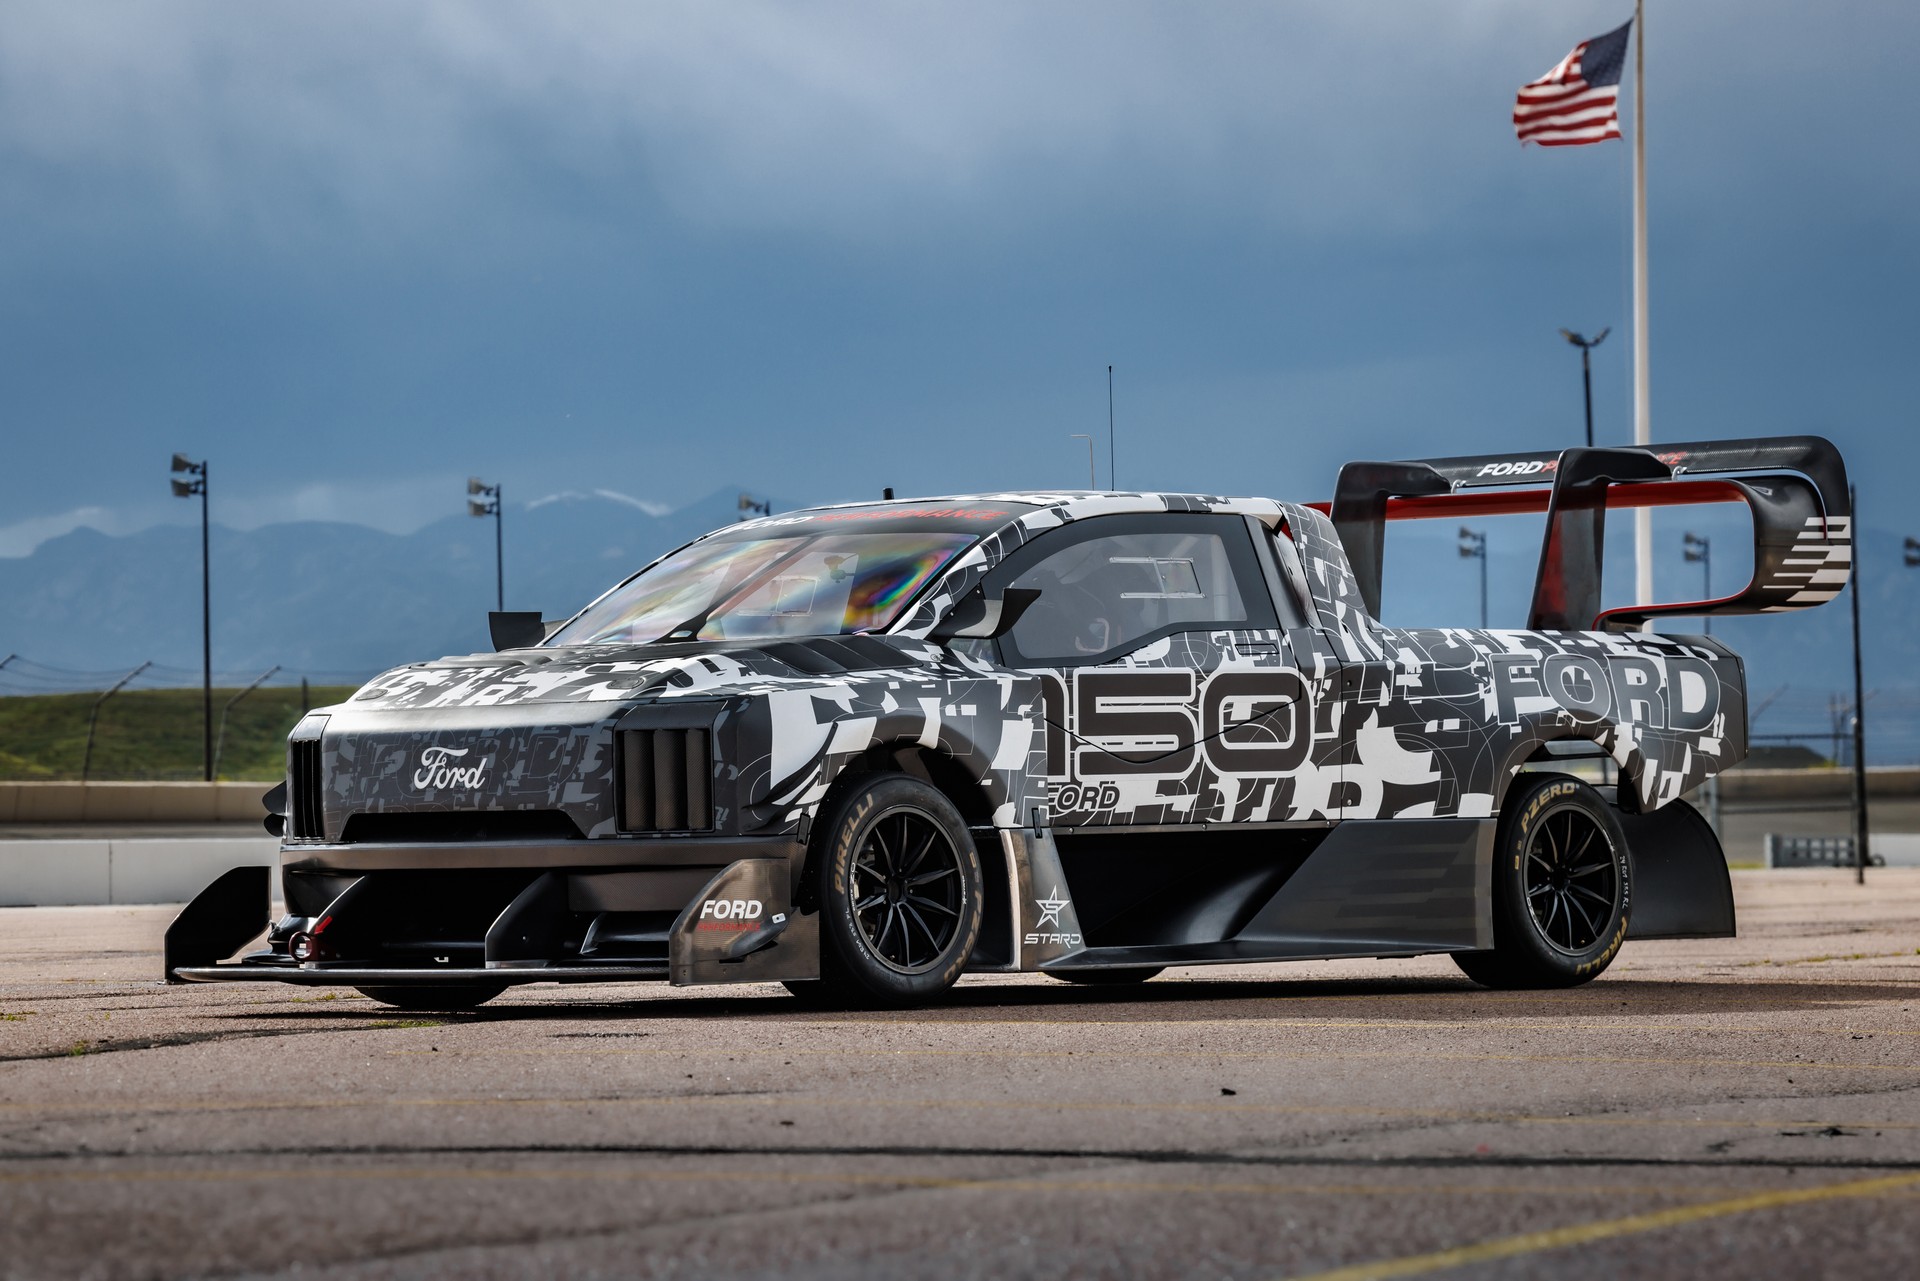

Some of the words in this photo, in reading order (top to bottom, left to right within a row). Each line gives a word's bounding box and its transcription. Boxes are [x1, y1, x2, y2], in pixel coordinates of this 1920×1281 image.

[1477, 460, 1544, 477] FORD
[1489, 653, 1721, 732] FORD
[414, 746, 488, 790] Ford
[834, 793, 874, 895] PIRELLI
[700, 900, 763, 919] FORD
[1023, 933, 1081, 949] STARD
